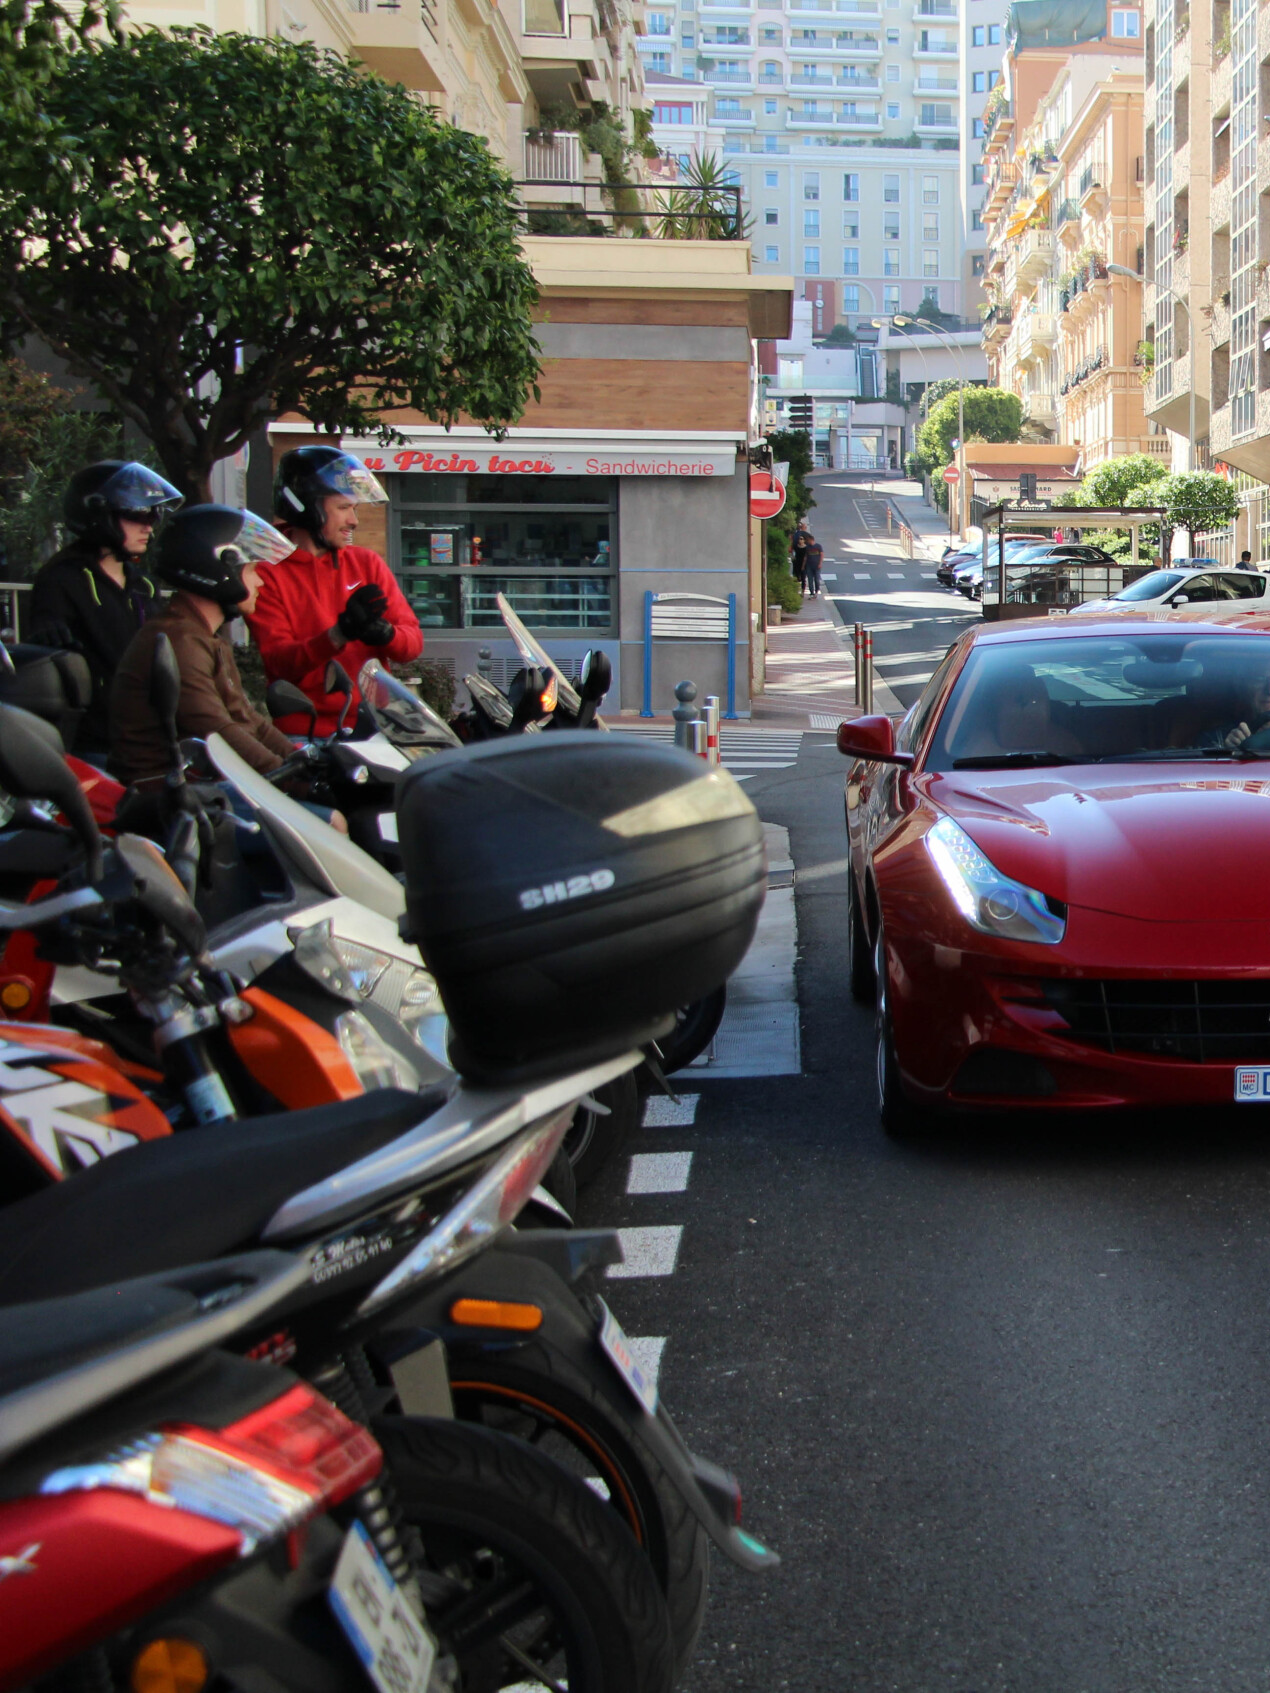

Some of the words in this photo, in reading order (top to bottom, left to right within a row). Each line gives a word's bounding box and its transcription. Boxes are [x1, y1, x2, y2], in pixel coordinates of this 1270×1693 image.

[393, 450, 480, 472] Picin
[585, 458, 715, 475] Sandwicherie
[519, 868, 616, 911] SH29
[1242, 1083, 1255, 1091] MC
